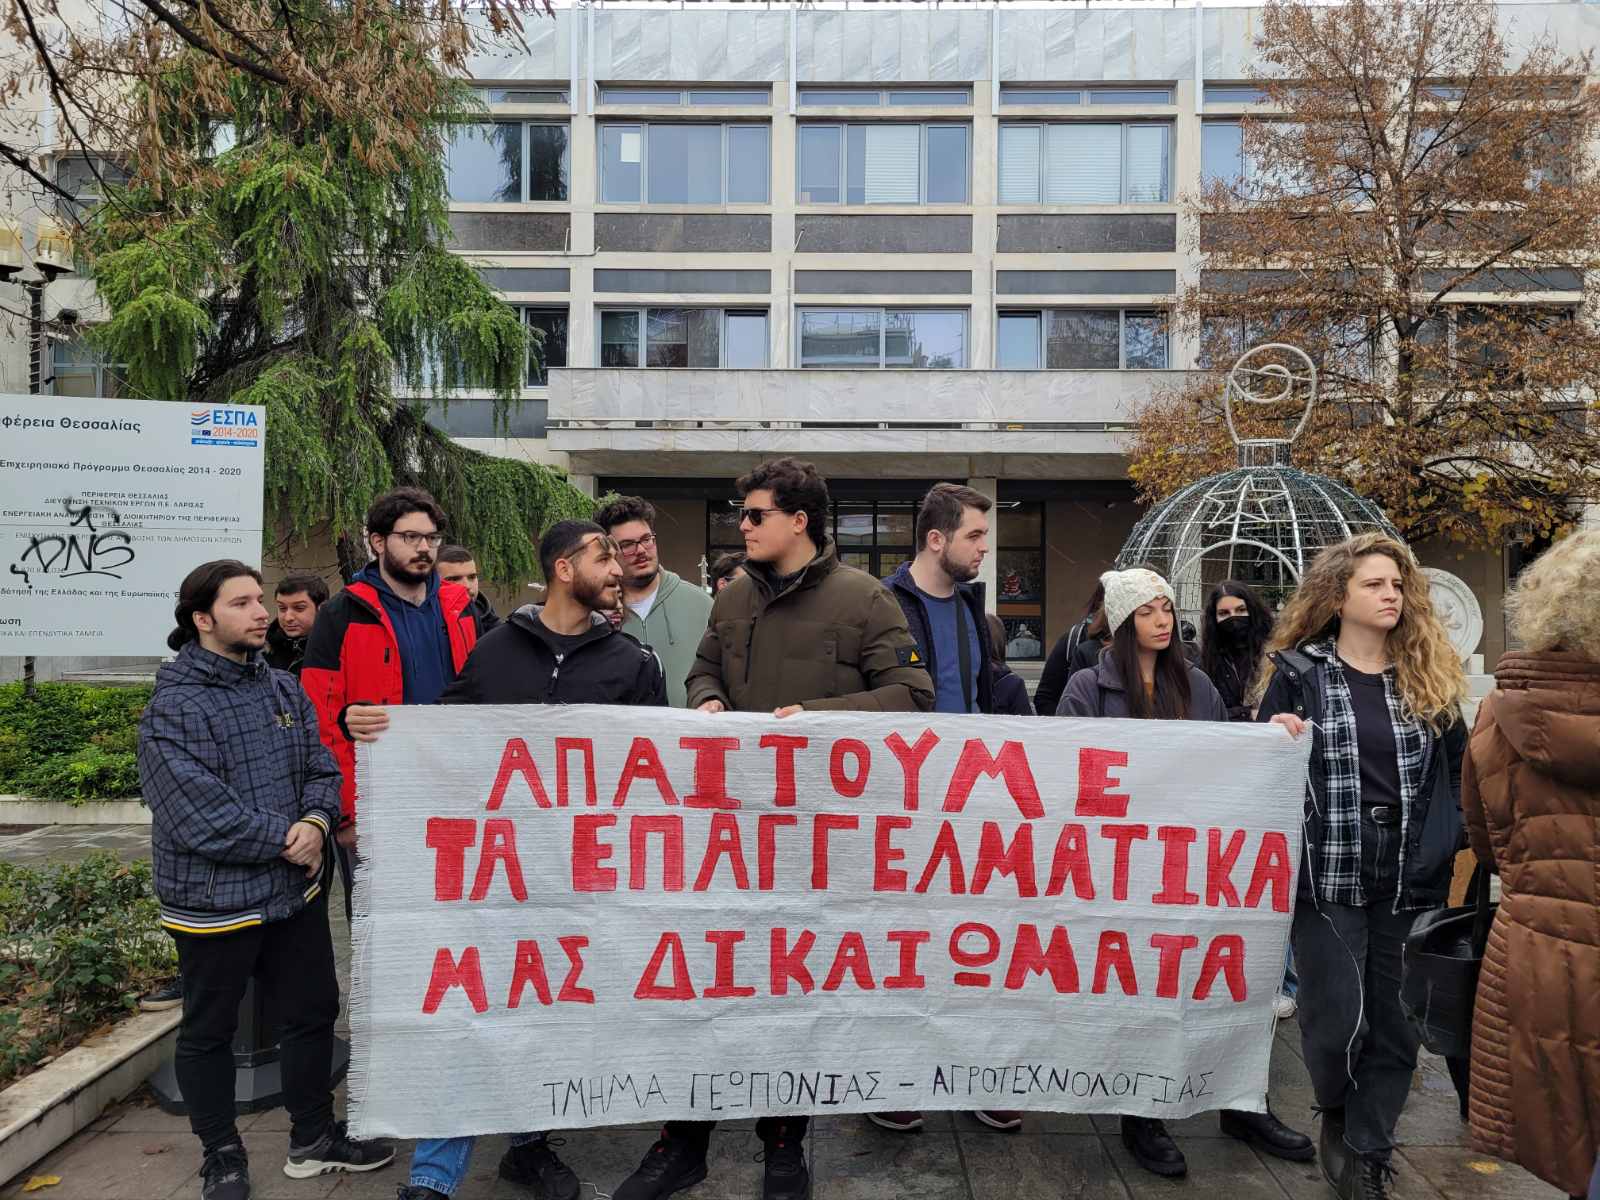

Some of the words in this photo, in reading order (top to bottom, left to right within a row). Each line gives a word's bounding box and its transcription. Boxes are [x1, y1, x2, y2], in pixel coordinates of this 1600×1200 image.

[60, 417, 141, 434] Θεσσαλίας
[213, 409, 258, 426] ΕΣΠΑ
[213, 427, 258, 438] 2014-2020
[73, 462, 130, 472] Πρόγραμμα
[133, 464, 185, 475] Θεσσαλίας
[188, 466, 211, 475] 2014
[219, 467, 242, 476] 2020
[485, 728, 1130, 819] ΑΠΑΙΤΟΥΜΕ
[426, 817, 529, 902] ΤΑ
[572, 814, 1290, 912] ΕΠΑΓΓΕΛΜΑΤΙΚΑ
[422, 936, 595, 1014] ΜΑΣ
[634, 922, 1247, 1002] ΔΙΚΑΙΩΜΑΤΑ
[543, 1073, 668, 1118] ΤΜΗΜΑ
[691, 1071, 887, 1110] ΓΕΩΠΟΝΙΑΣ
[933, 1064, 1215, 1104] ΑΓΡΟΤΕΧΝΟΛΟΓΙΑΣ
